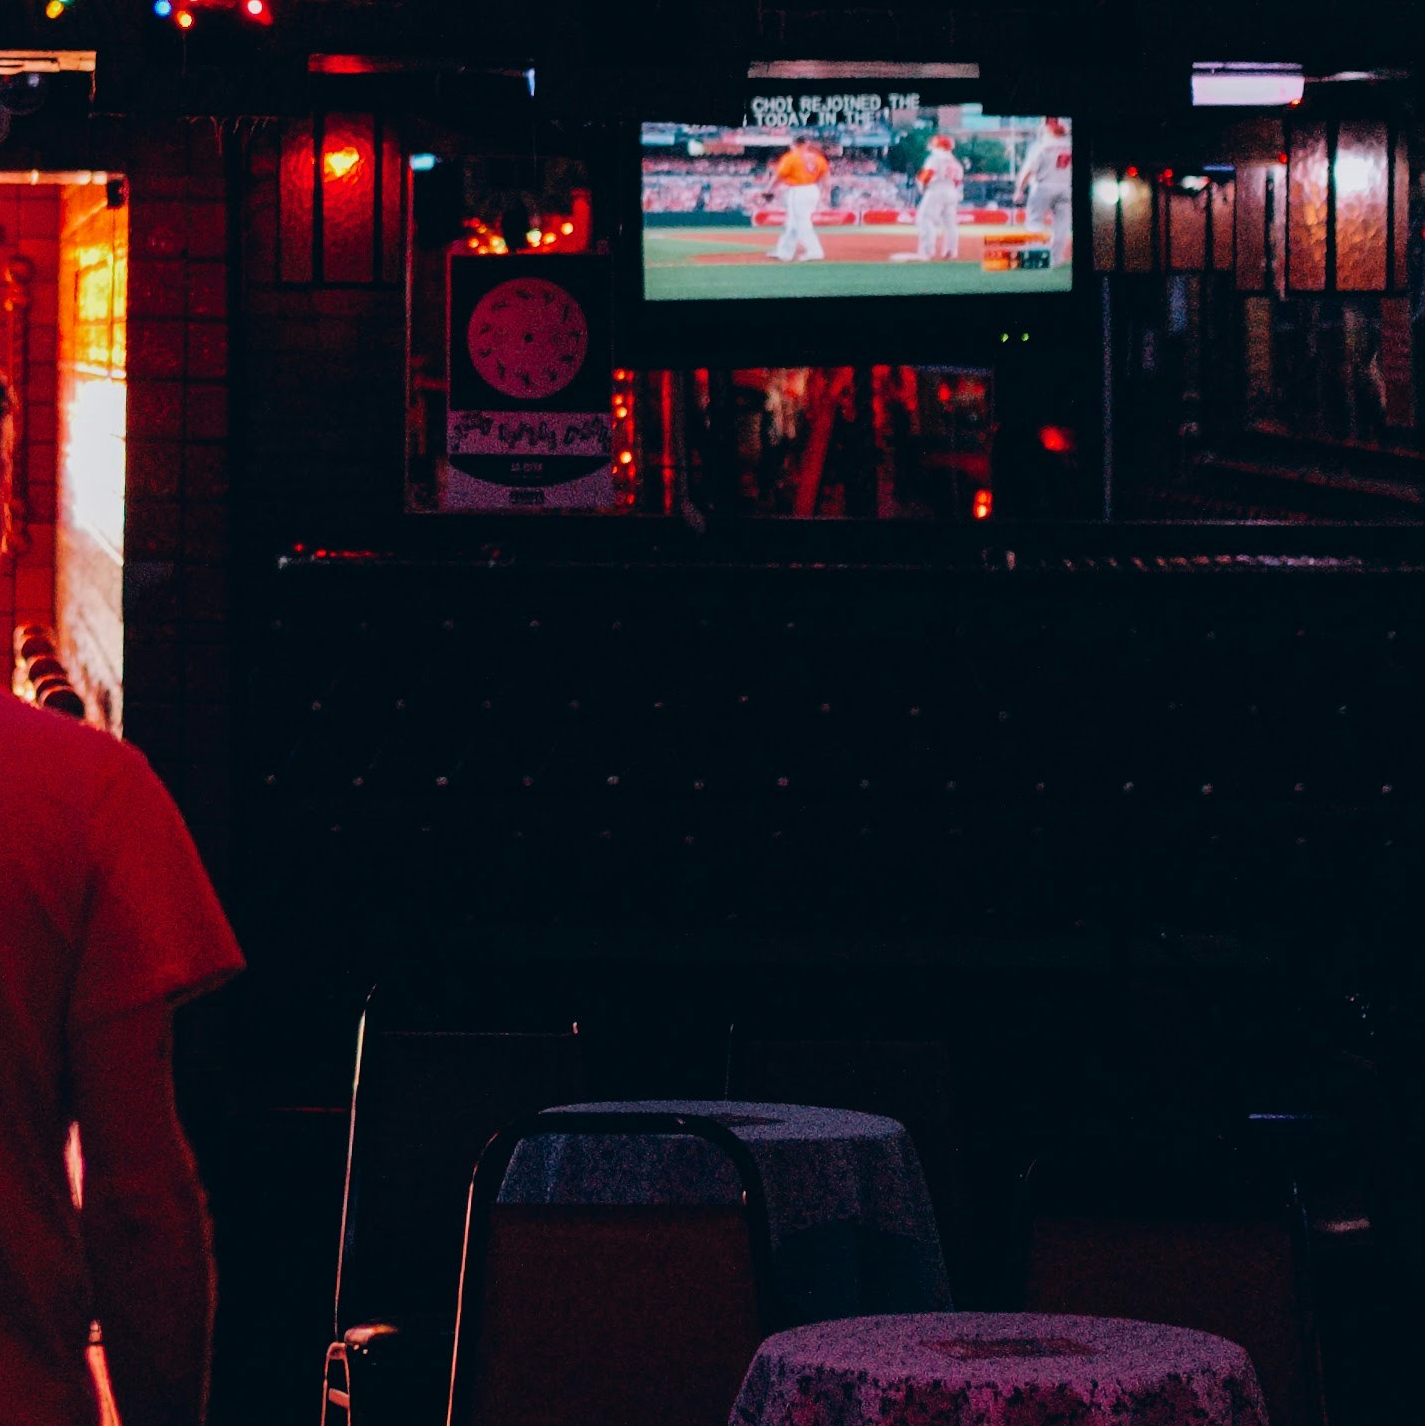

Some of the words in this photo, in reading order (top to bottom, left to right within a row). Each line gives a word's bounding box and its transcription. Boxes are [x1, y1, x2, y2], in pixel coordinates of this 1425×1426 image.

[750, 95, 793, 113] CHOI
[799, 93, 881, 112] REJOINED
[888, 92, 920, 110] THE
[755, 112, 810, 127] TODAY
[817, 111, 837, 127] IN
